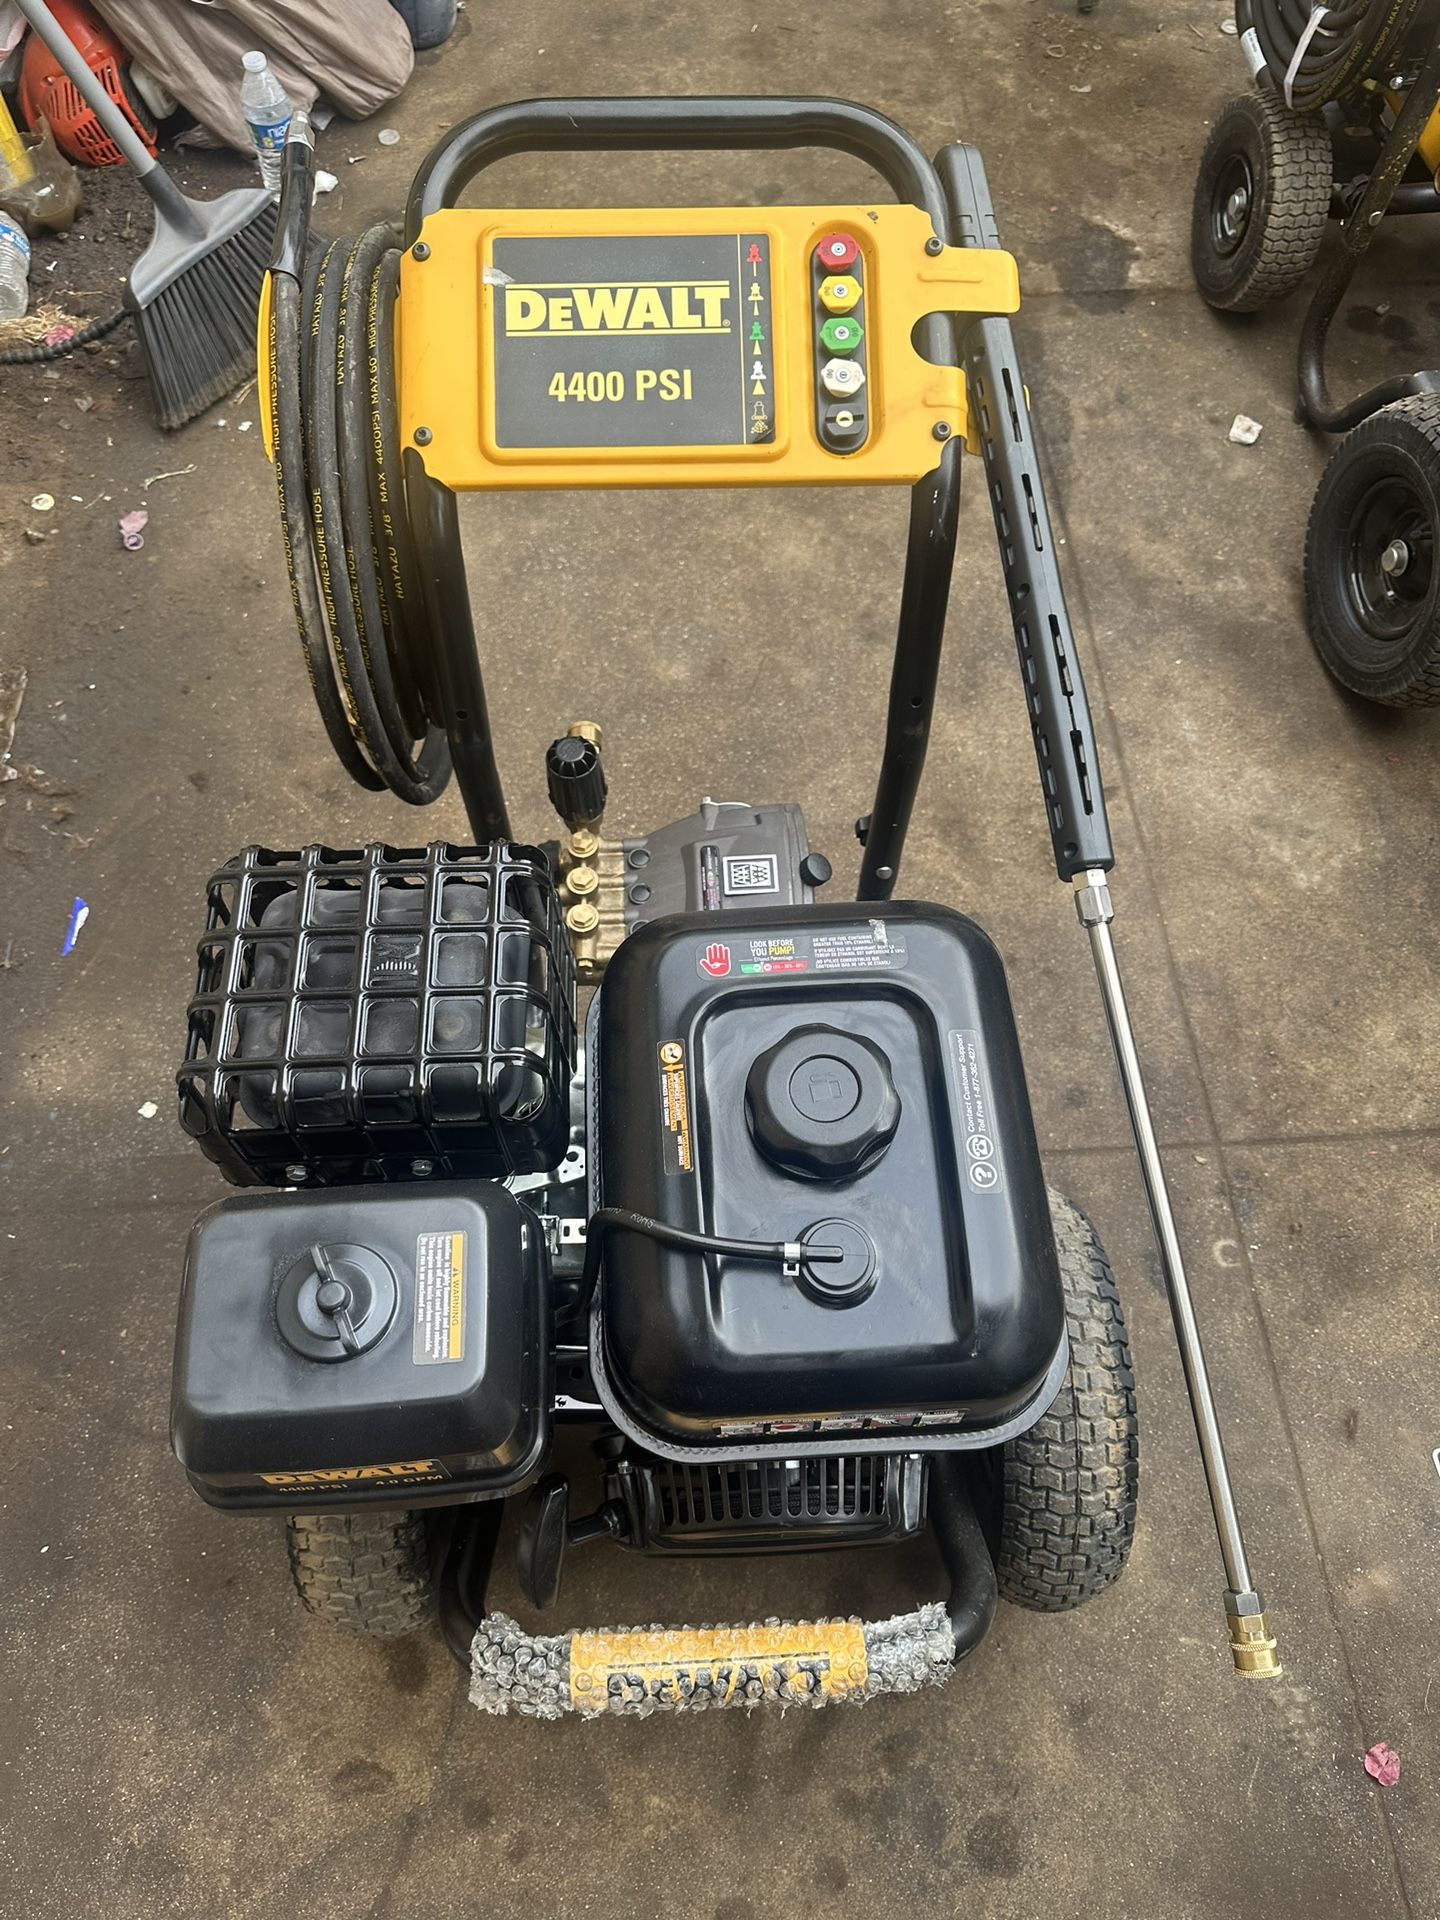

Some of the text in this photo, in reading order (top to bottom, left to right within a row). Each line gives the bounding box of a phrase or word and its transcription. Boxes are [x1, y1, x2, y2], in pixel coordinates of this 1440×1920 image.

[369, 281, 379, 322] PRESSURE
[367, 323, 378, 349] HIGH
[336, 335, 346, 385] HAYAZU
[369, 376, 380, 404] MAX
[548, 369, 692, 402] 4400 PSI
[371, 410, 385, 465] 4400PSI
[278, 483, 288, 514] MAX
[377, 472, 389, 503] MAX
[311, 488, 324, 524] HOSE
[315, 527, 332, 593] PRESSURE
[387, 547, 405, 599] HAYAZU
[324, 597, 337, 627] HIGH
[750, 938, 794, 948] LOOK BEFORE
[751, 945, 795, 957] YOU PUMP!
[955, 1033, 976, 1132] Contact Customer Support
[974, 1100, 985, 1118] Free
[976, 1118, 986, 1132] Toll
[682, 1137, 690, 1167] WARNING
[451, 1279, 460, 1327] WARNING
[279, 1482, 349, 1493] 4400 PSI
[403, 1474, 444, 1484] GPM
